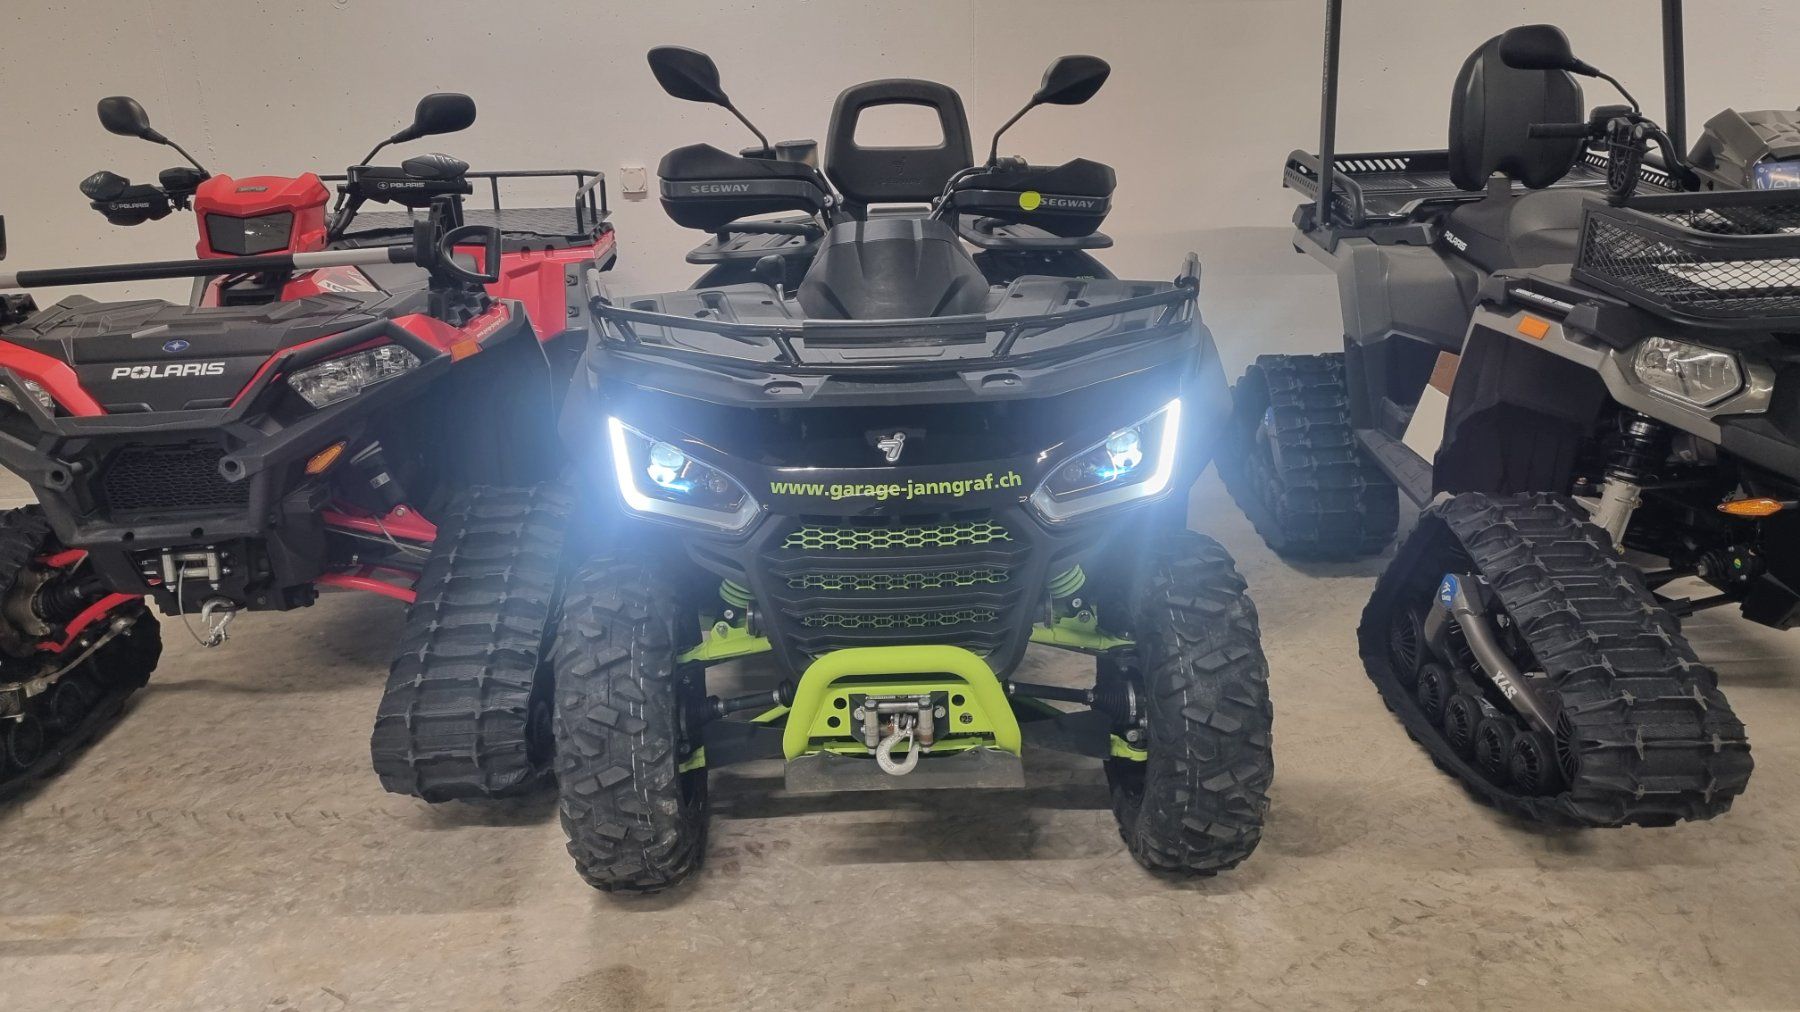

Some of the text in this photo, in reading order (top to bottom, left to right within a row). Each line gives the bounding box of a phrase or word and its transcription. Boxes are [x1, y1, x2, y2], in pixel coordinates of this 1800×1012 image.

[690, 184, 750, 193] SEGWAY
[1040, 198, 1095, 208] SEGWAY
[1444, 230, 1468, 251] POLARIS
[111, 362, 225, 380] POLARIS
[770, 471, 1022, 500] www.garage-janngraf.ch
